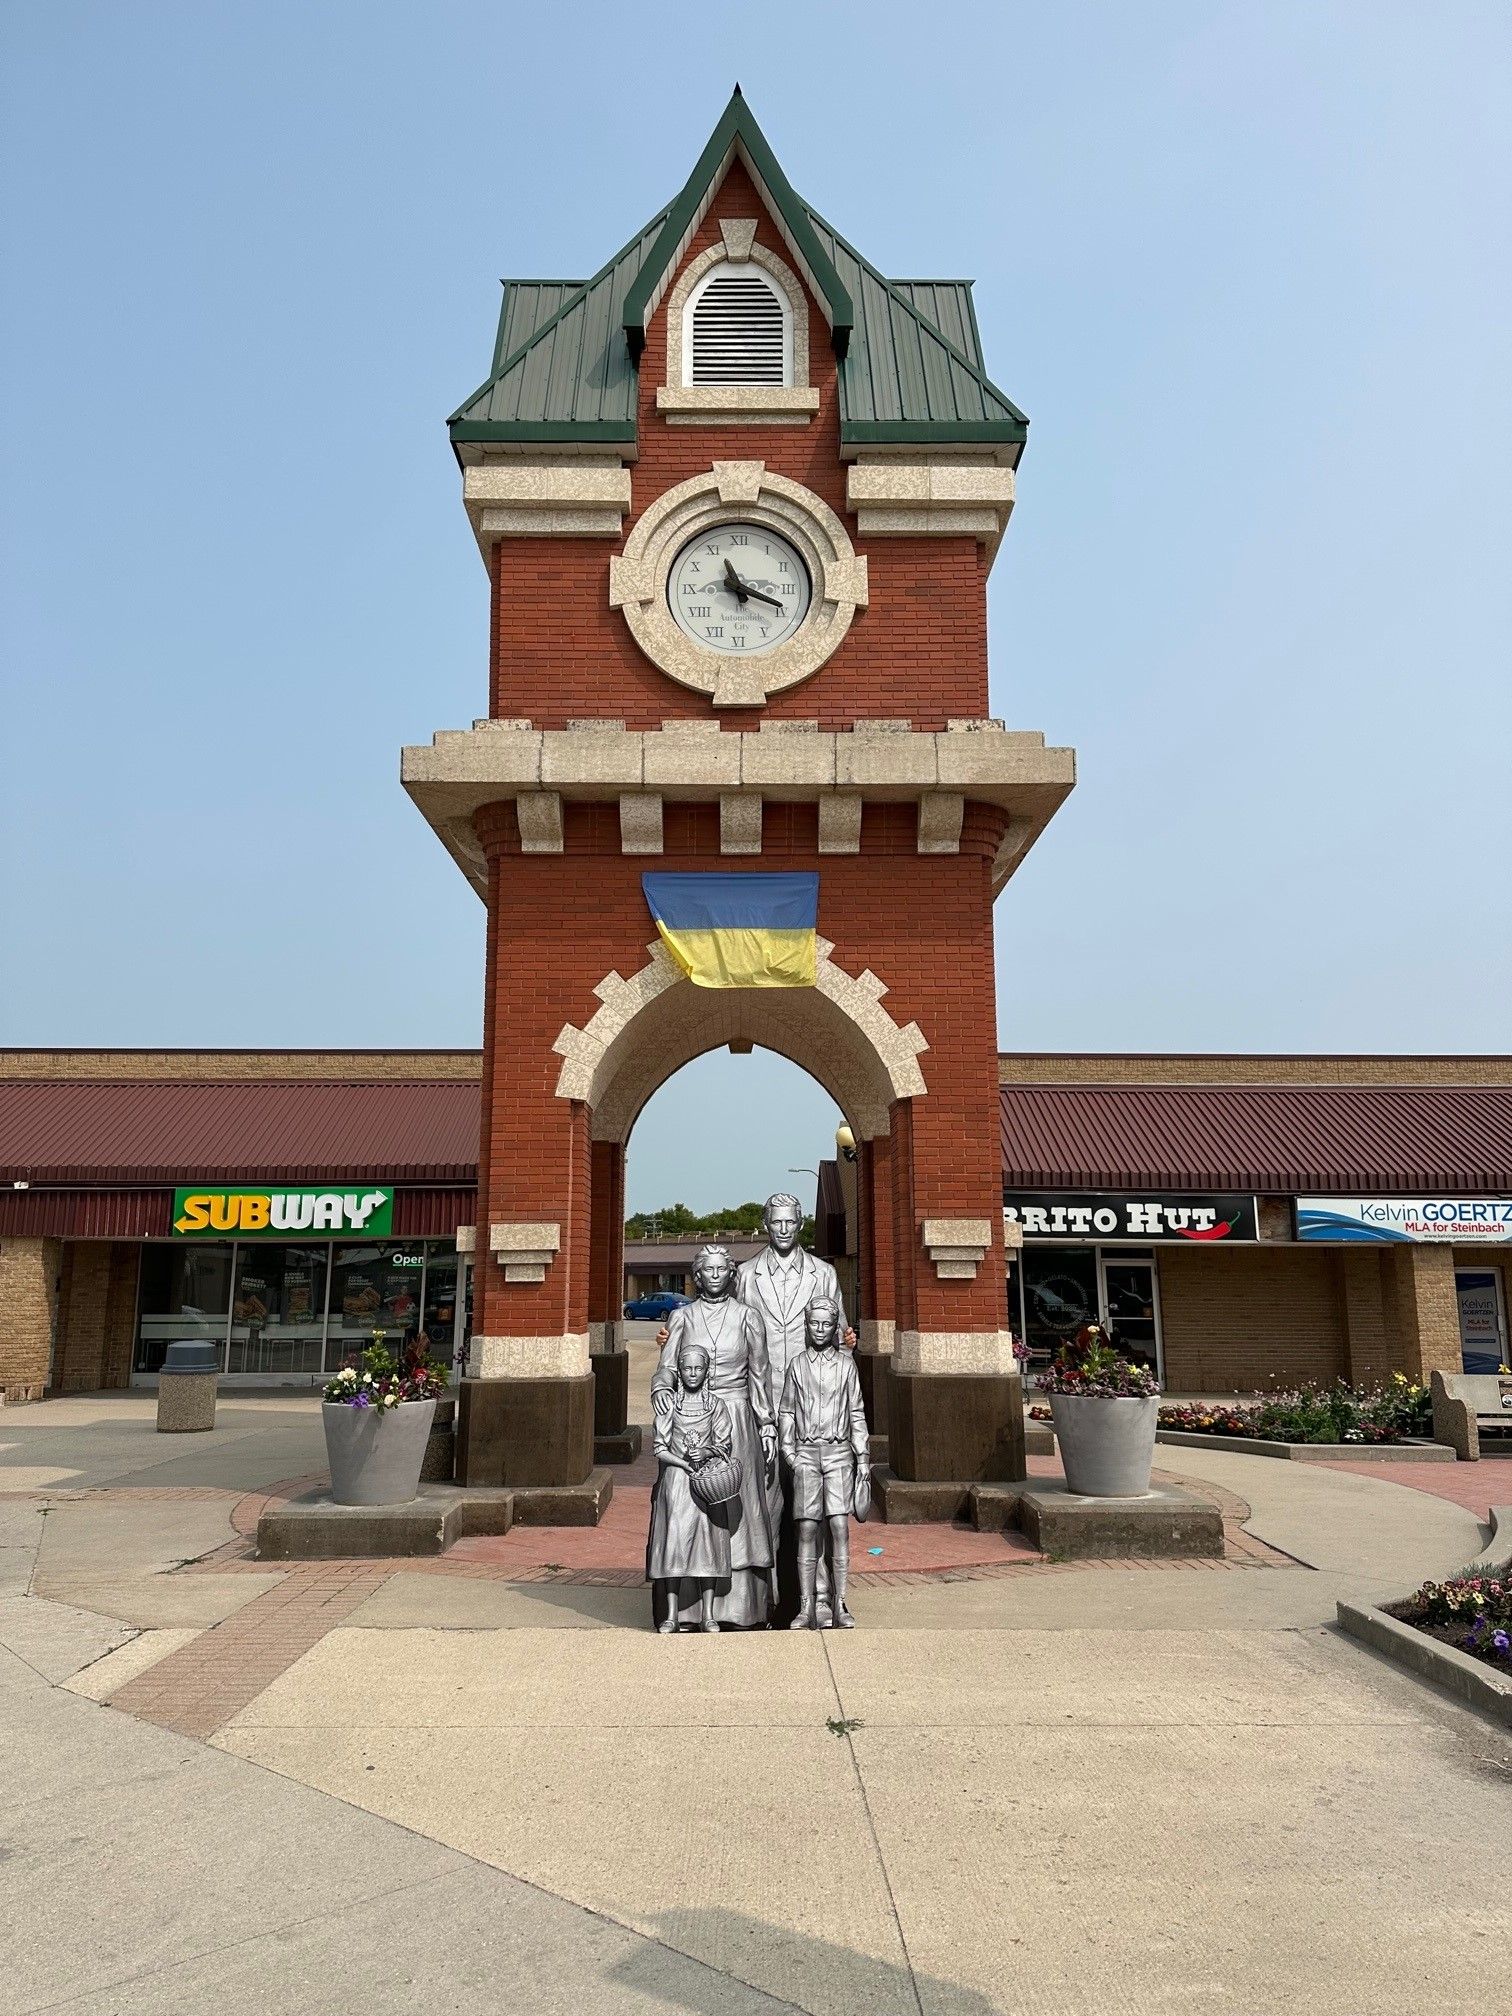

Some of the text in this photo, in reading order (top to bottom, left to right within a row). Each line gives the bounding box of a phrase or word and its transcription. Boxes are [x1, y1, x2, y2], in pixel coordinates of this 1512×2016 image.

[730, 535, 748, 546] XII
[706, 545, 719, 555] XI
[765, 546, 770, 555] I
[691, 562, 700, 572] X
[779, 562, 788, 572] II
[682, 583, 697, 595] IX
[781, 584, 795, 595] III
[688, 606, 711, 617] VIII
[720, 613, 764, 622] Automobile
[705, 626, 723, 638] VII
[734, 623, 750, 632] City
[760, 627, 769, 638] V
[731, 636, 746, 648] VI
[174, 1190, 388, 1233] SUBWAY
[1360, 1203, 1418, 1222] Kelvin
[1405, 1222, 1505, 1233] MLA for Steinbach
[1461, 1299, 1494, 1310] Kelvin
